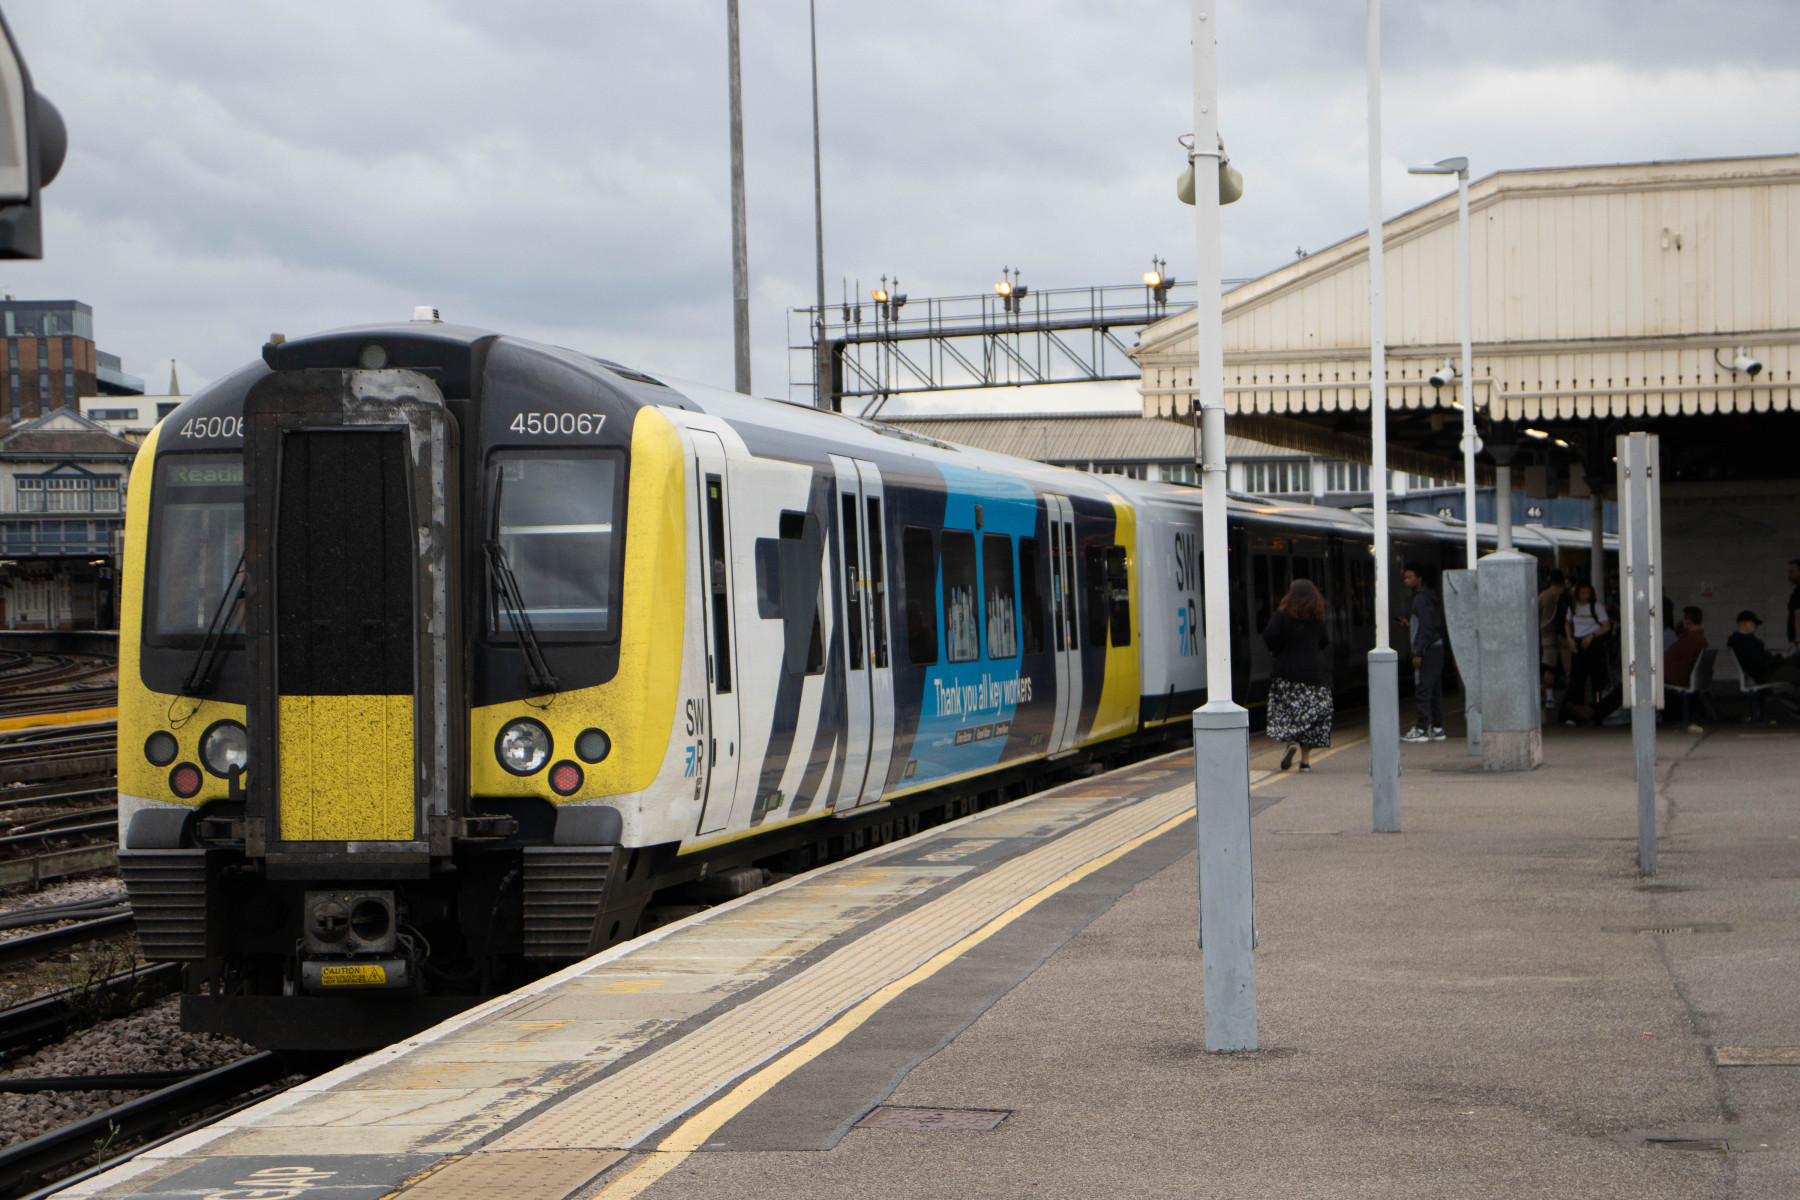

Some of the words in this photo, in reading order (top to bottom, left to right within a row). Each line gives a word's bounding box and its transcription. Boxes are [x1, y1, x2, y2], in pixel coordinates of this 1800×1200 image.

[509, 412, 606, 435] 450067
[1439, 508, 1452, 518] 45
[1527, 507, 1541, 517] 46
[934, 676, 961, 717] Thank
[962, 684, 977, 723] you
[979, 673, 988, 711] all
[989, 673, 1002, 716] key
[1003, 669, 1032, 706] workers
[686, 698, 704, 736] SW
[323, 967, 360, 975] CAUTION
